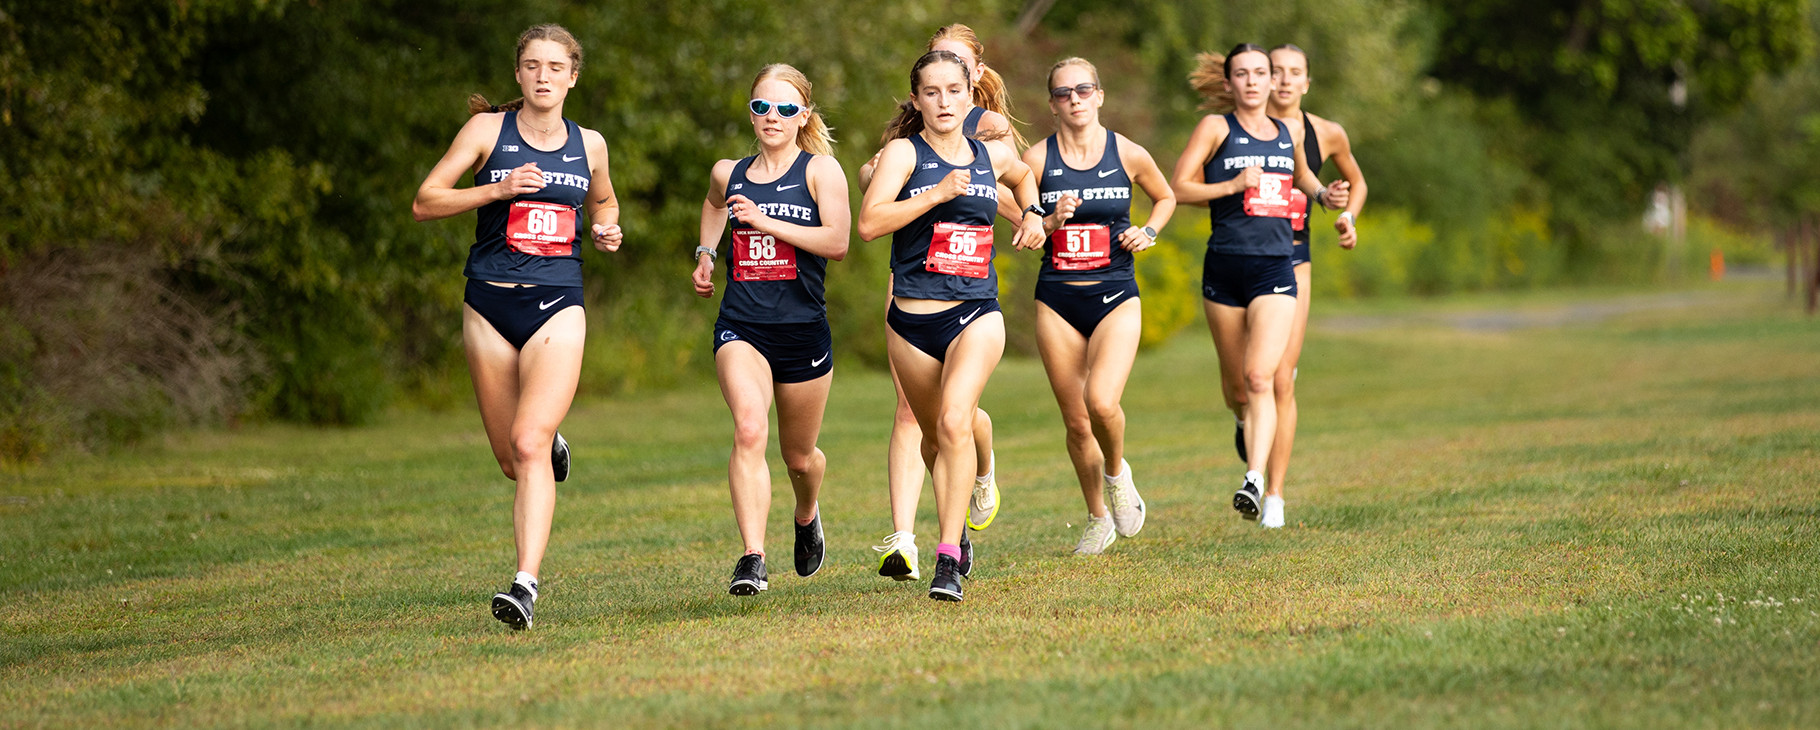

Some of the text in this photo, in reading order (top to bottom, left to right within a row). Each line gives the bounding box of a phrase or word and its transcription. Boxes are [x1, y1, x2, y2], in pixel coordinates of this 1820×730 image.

[1224, 155, 1266, 170] PENN
[542, 170, 590, 192] STATE
[1082, 187, 1130, 200] STATE
[527, 208, 557, 235] 60
[758, 203, 812, 221] STATE
[513, 232, 536, 240] CROSS
[537, 234, 568, 243] COUNTRY
[748, 234, 777, 260] 58
[948, 230, 977, 256] 55
[1066, 230, 1090, 252] 51
[934, 251, 957, 260] CROSS
[957, 254, 985, 264] COUNTRY
